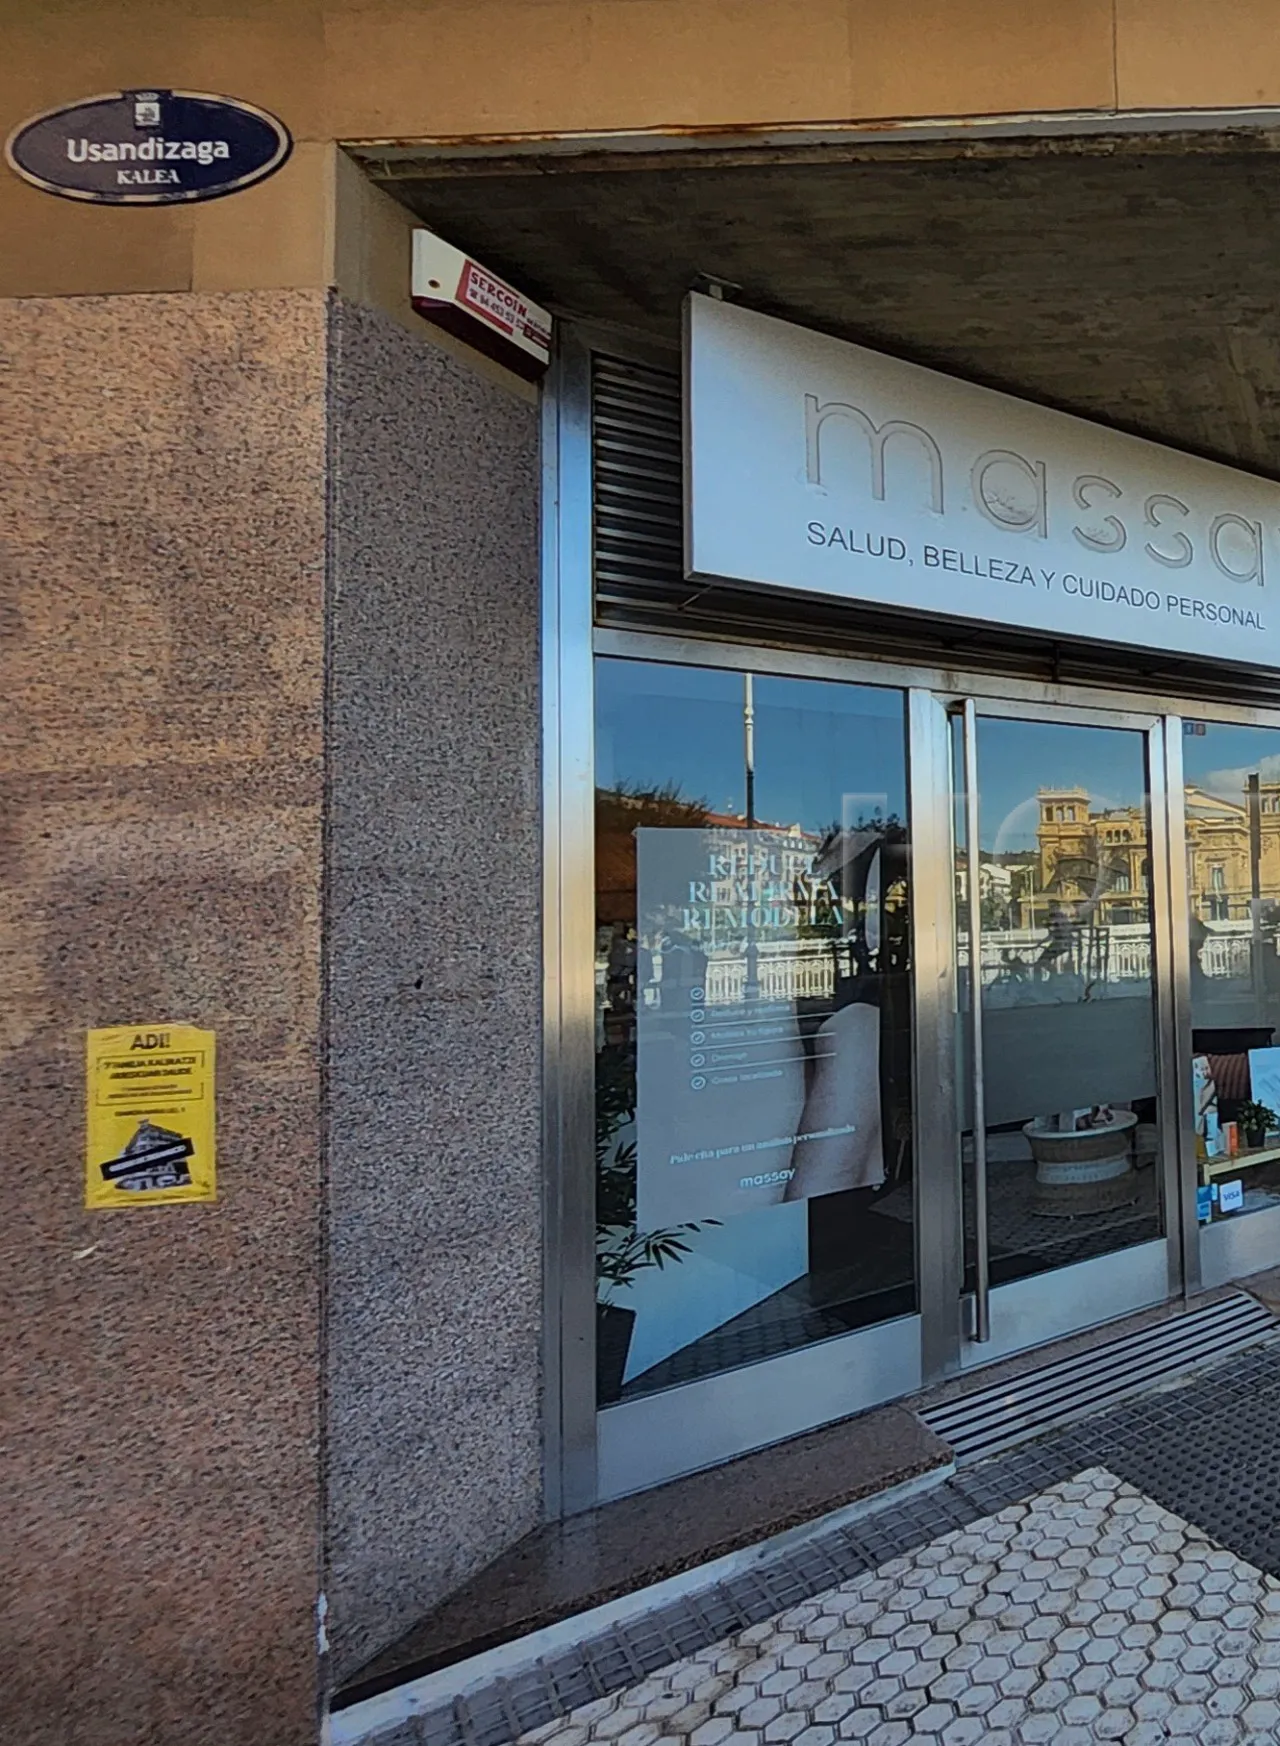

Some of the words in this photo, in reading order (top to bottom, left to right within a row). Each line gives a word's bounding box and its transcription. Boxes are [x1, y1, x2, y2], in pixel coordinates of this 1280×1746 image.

[67, 137, 230, 165] Usandizaga
[116, 168, 181, 185] KALEA
[471, 271, 528, 318] SERCOIN
[806, 521, 915, 567] SALUD,
[923, 545, 1036, 587] BELLEZA
[1040, 568, 1056, 590] Y
[1062, 574, 1161, 610] CUIDADO
[1166, 594, 1267, 631] PERSONAL
[740, 1167, 796, 1189] massay
